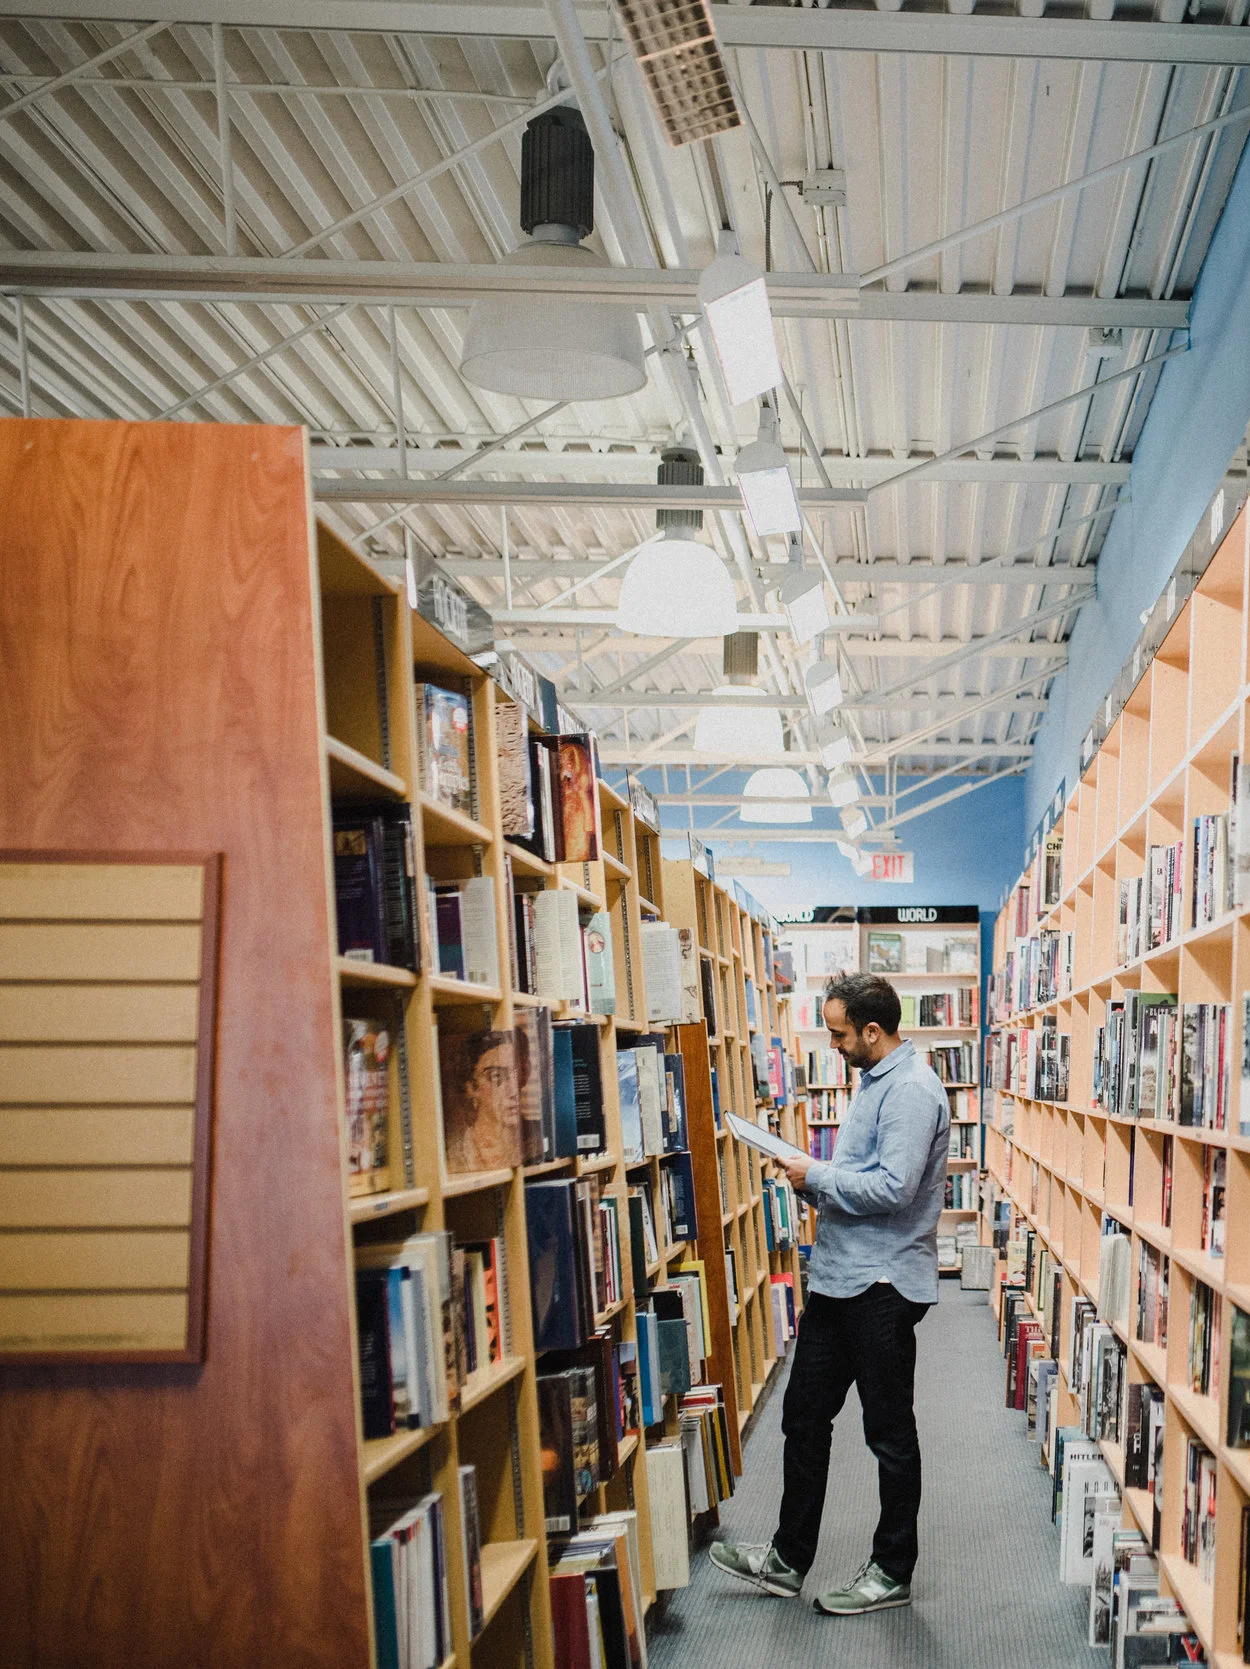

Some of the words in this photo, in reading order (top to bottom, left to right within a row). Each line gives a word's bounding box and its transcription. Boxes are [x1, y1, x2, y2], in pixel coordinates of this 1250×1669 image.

[872, 855, 905, 879] EXIT
[898, 908, 938, 922] WORLD
[1070, 1453, 1104, 1461] HITLER
